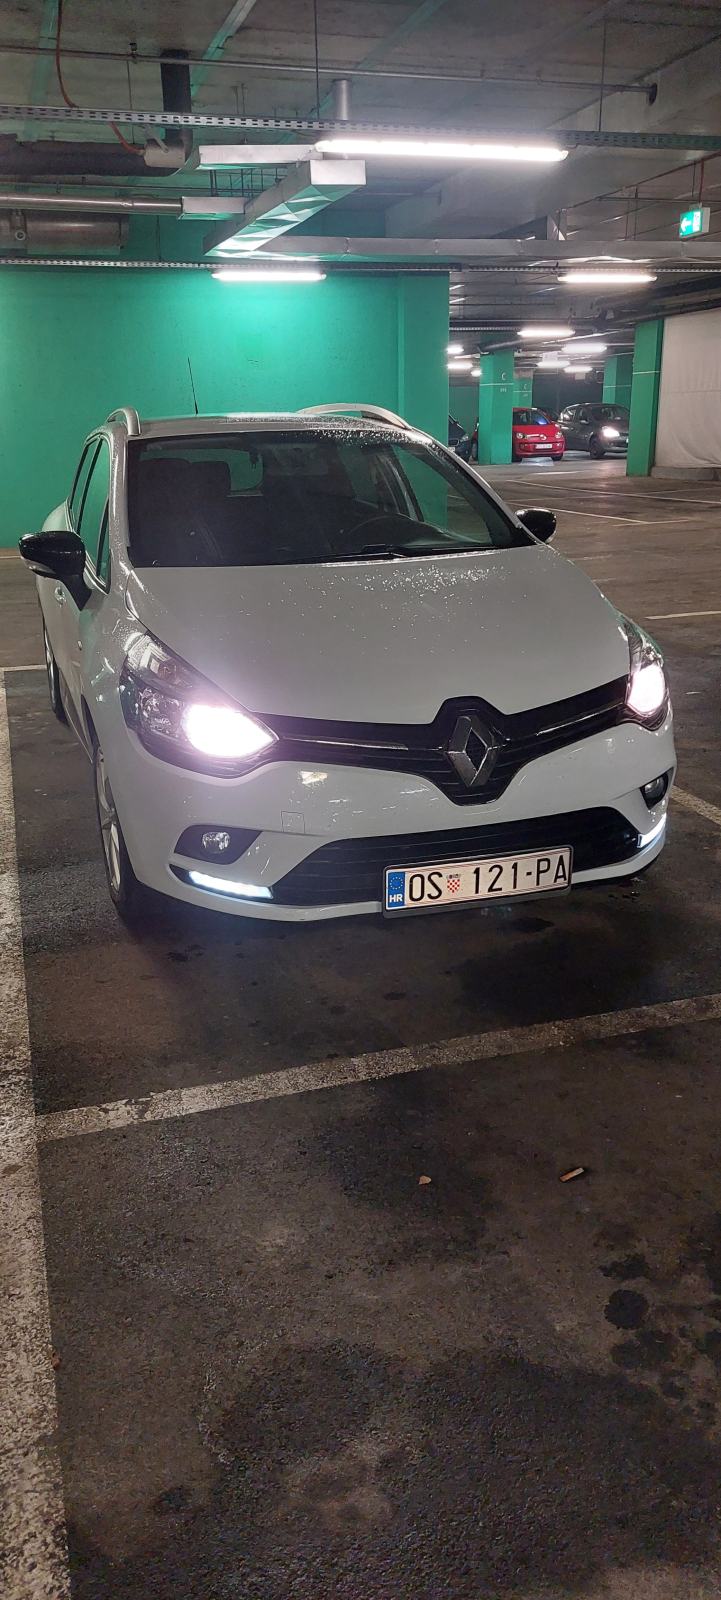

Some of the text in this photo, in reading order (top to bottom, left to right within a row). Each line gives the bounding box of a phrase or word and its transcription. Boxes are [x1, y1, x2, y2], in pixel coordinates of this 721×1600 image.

[409, 855, 567, 902] OS 121-PA
[389, 894, 403, 903] HR
